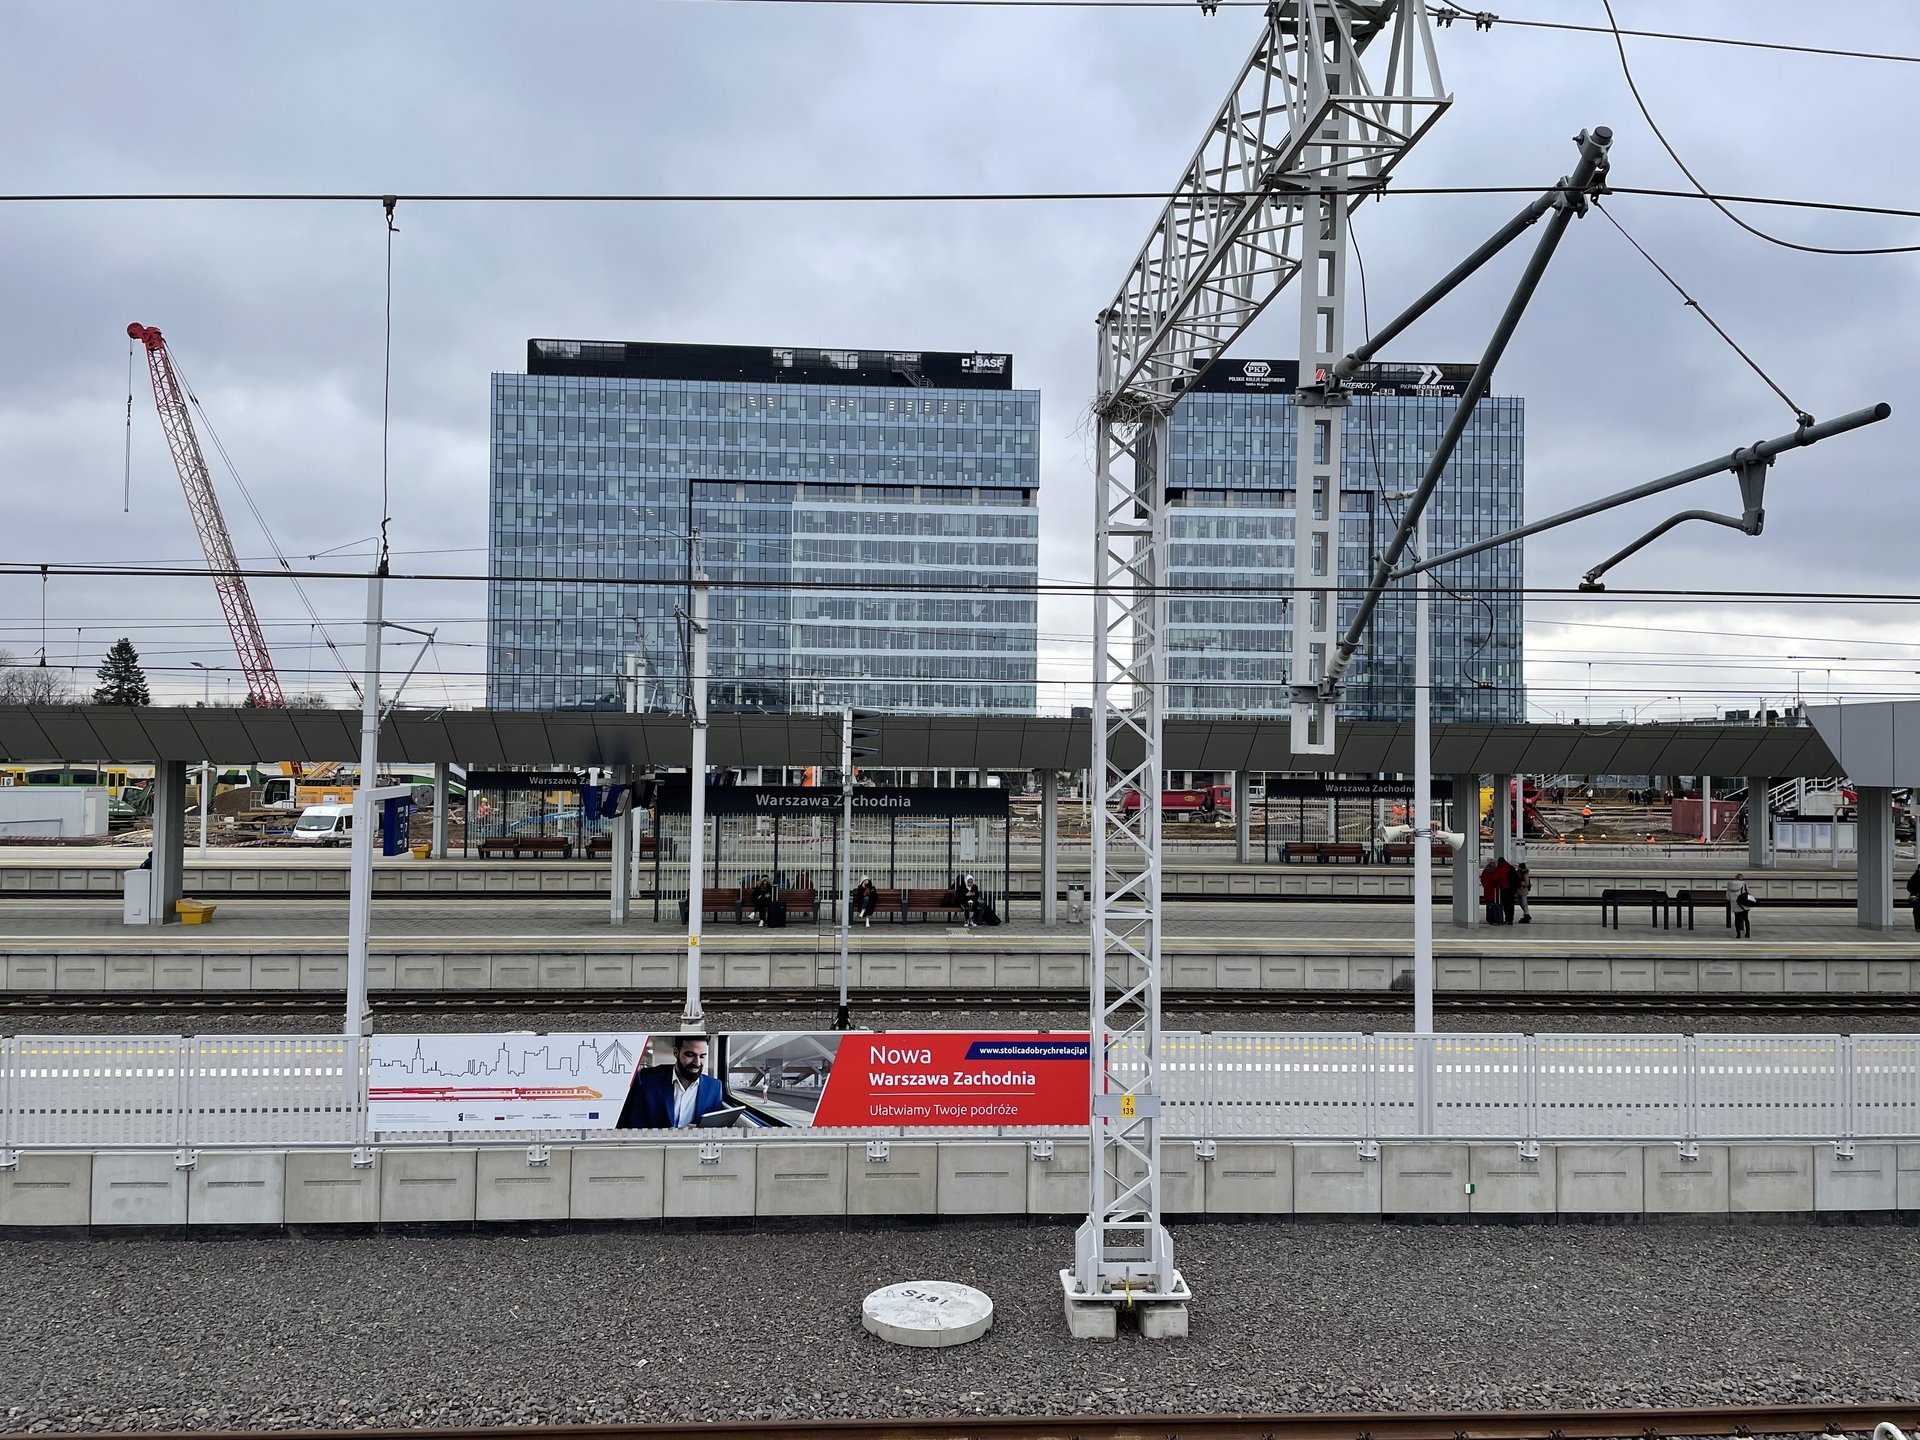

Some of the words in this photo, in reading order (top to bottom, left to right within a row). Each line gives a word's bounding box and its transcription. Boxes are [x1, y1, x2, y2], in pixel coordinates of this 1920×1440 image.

[976, 359, 1004, 367] BASF
[529, 776, 577, 785] Warszawa
[1325, 784, 1370, 792] Warszawa
[1372, 784, 1415, 793] Zachodni
[755, 794, 830, 806] Warszawa
[833, 794, 911, 807] Zchodnia
[870, 1045, 932, 1064] Nowa
[979, 1046, 1088, 1056] www.stolicadobrychrelacji.pl
[868, 1072, 949, 1086] Warszawa
[953, 1070, 1036, 1086] Zachodnia
[1126, 1097, 1131, 1106] 2
[869, 1104, 931, 1118] Ułatwiamy
[933, 1103, 968, 1118] Twoje
[970, 1103, 1019, 1118] podróże
[1122, 1107, 1135, 1115] 139
